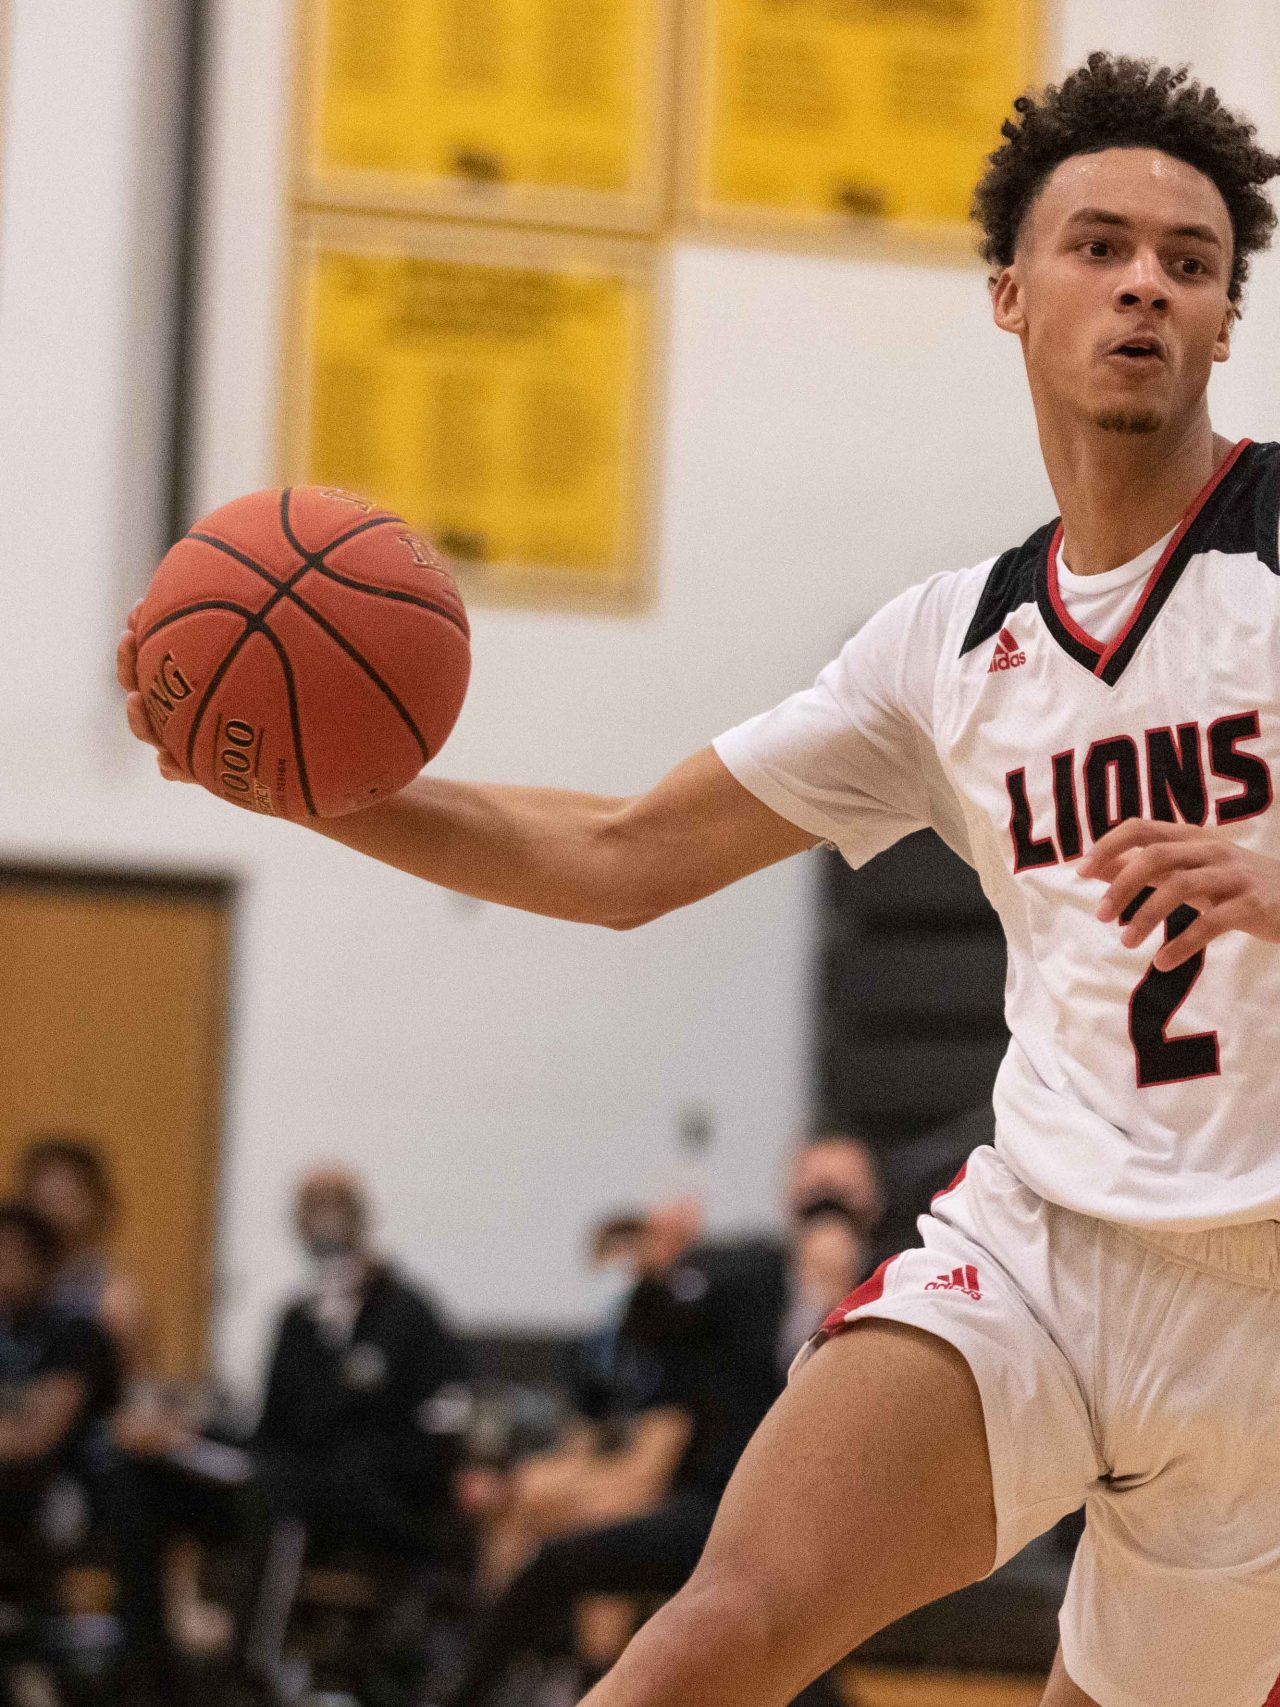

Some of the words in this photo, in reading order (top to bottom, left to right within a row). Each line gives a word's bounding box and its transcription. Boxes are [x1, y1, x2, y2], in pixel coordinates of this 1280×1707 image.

[987, 651, 1026, 673] idas
[1005, 709, 1274, 875] LIONS
[1118, 885, 1221, 1089] 2
